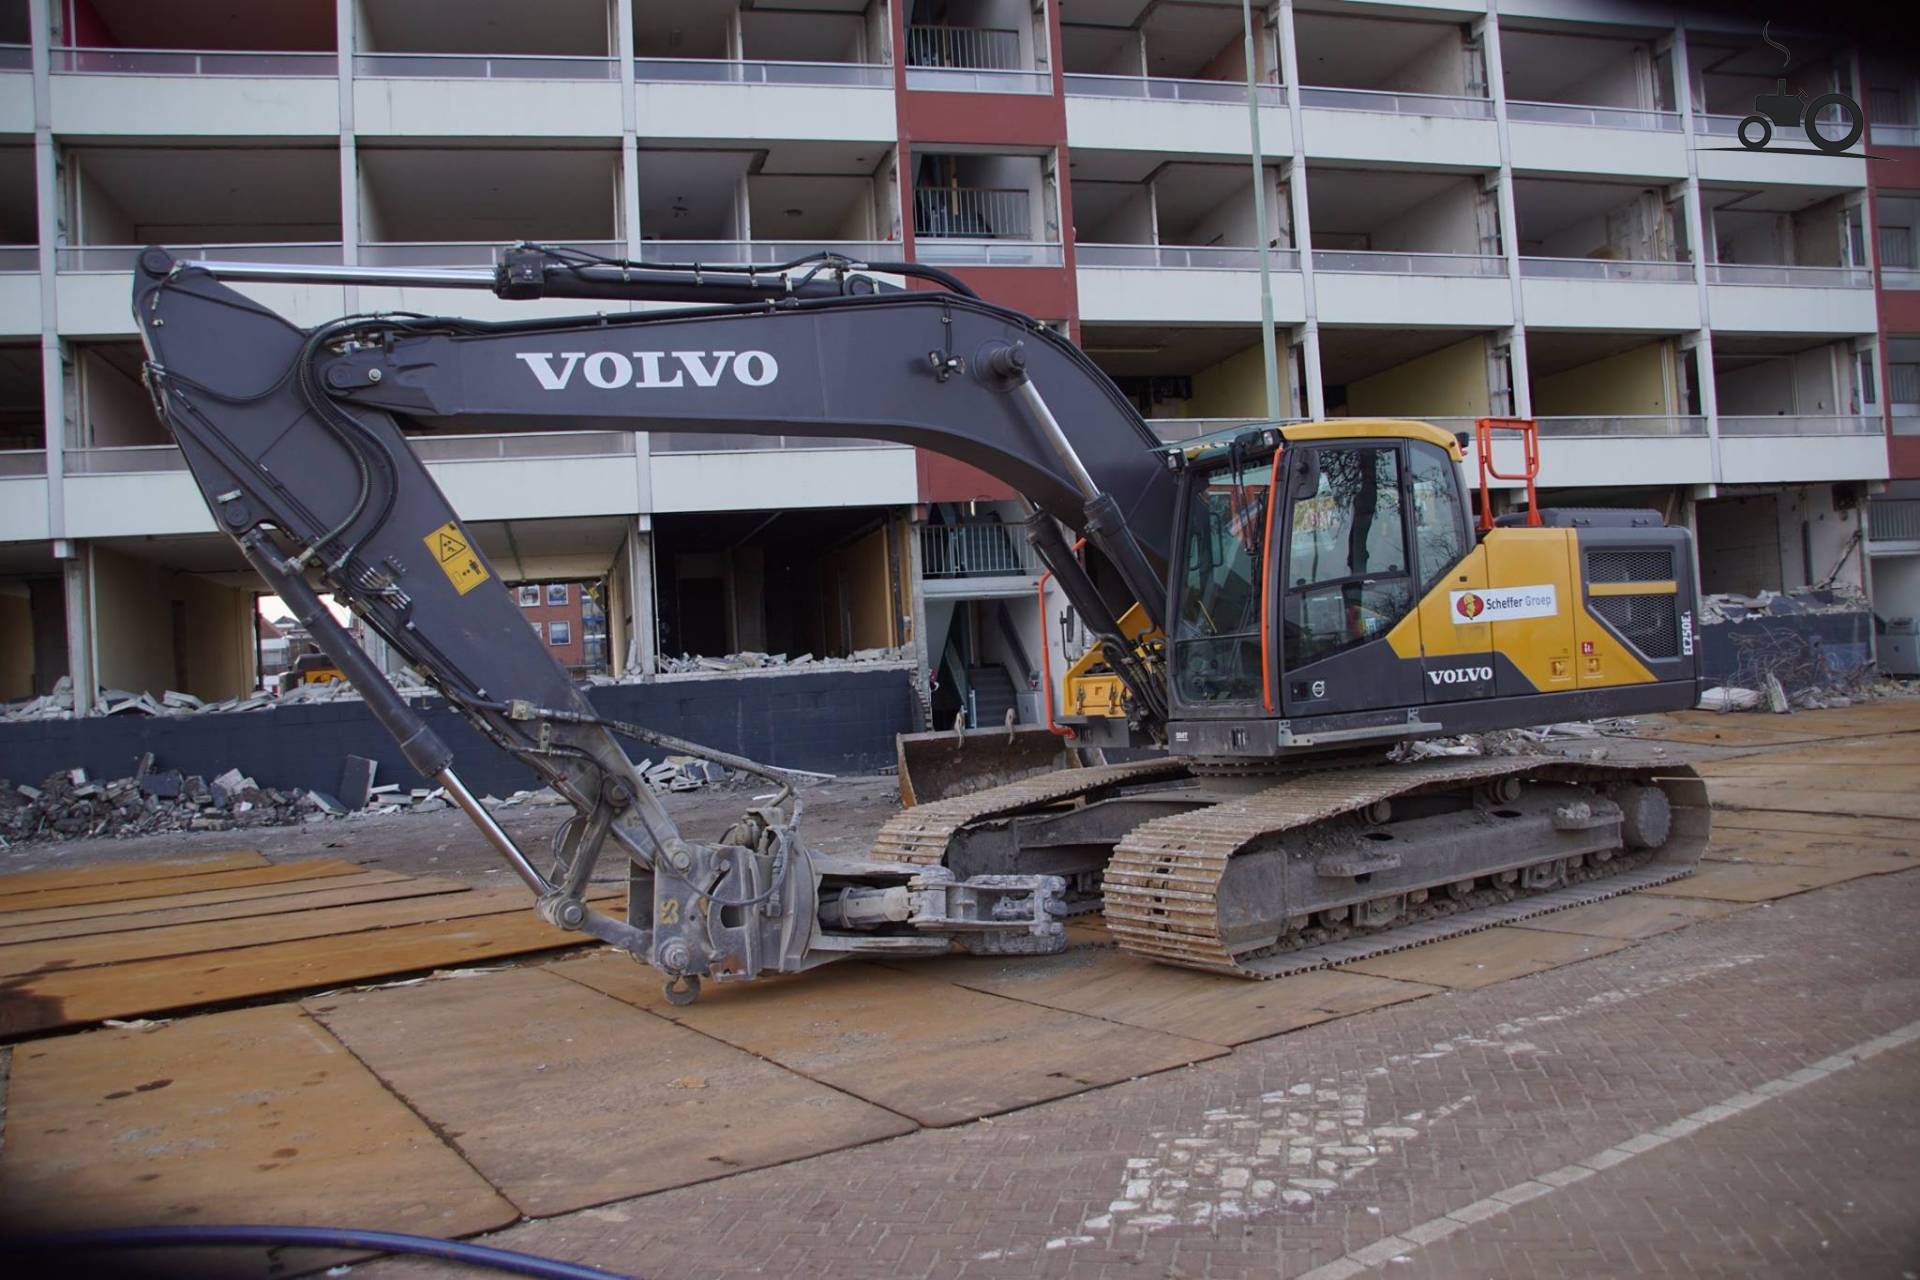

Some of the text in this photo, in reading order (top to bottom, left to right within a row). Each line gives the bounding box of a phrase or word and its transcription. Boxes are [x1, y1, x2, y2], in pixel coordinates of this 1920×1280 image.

[516, 350, 778, 390] VOLVO
[1486, 595, 1551, 610] Scheffer Groep
[1427, 666, 1493, 685] VOLVO
